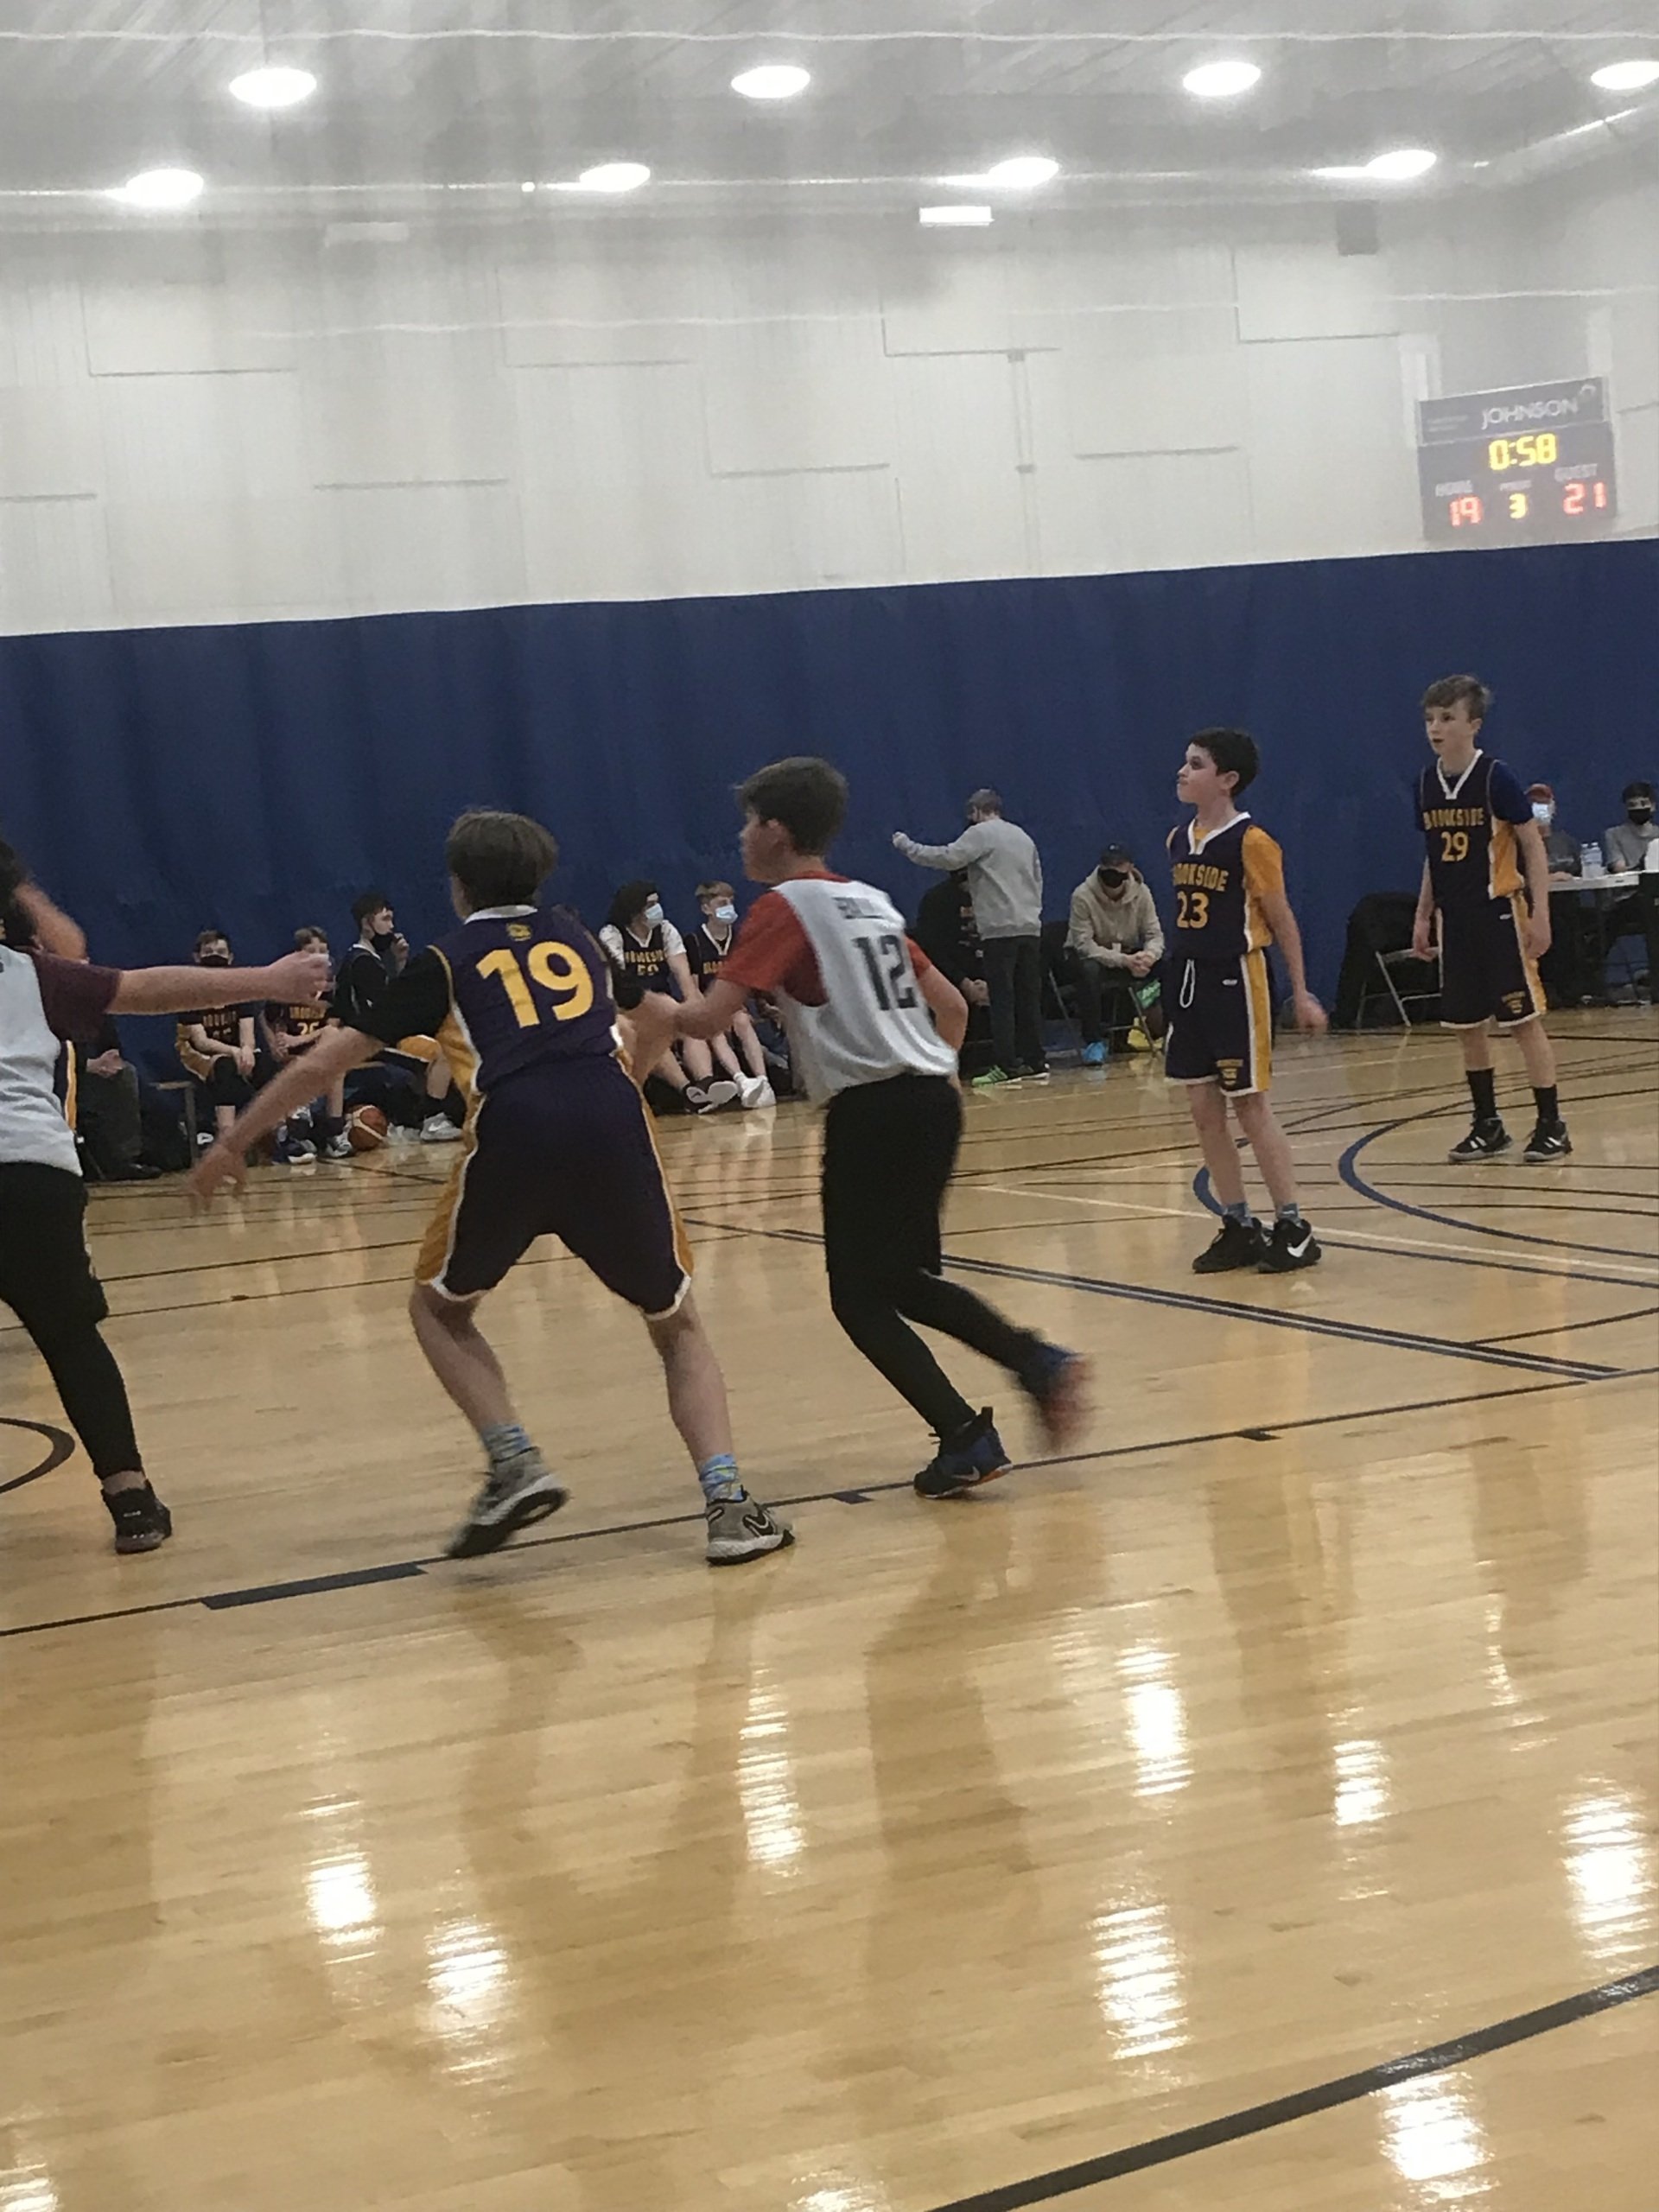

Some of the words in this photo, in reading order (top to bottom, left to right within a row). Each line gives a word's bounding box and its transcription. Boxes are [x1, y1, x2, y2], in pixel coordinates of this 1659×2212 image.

[1480, 397, 1580, 430] JOHNSON
[1488, 433, 1558, 471] 0:58
[1449, 496, 1483, 526] 19
[1509, 493, 1528, 519] 3
[1563, 482, 1606, 515] 21
[1440, 831, 1469, 861] 29
[1177, 890, 1209, 929] 23
[475, 940, 594, 1029] 19
[851, 934, 918, 1011] 12
